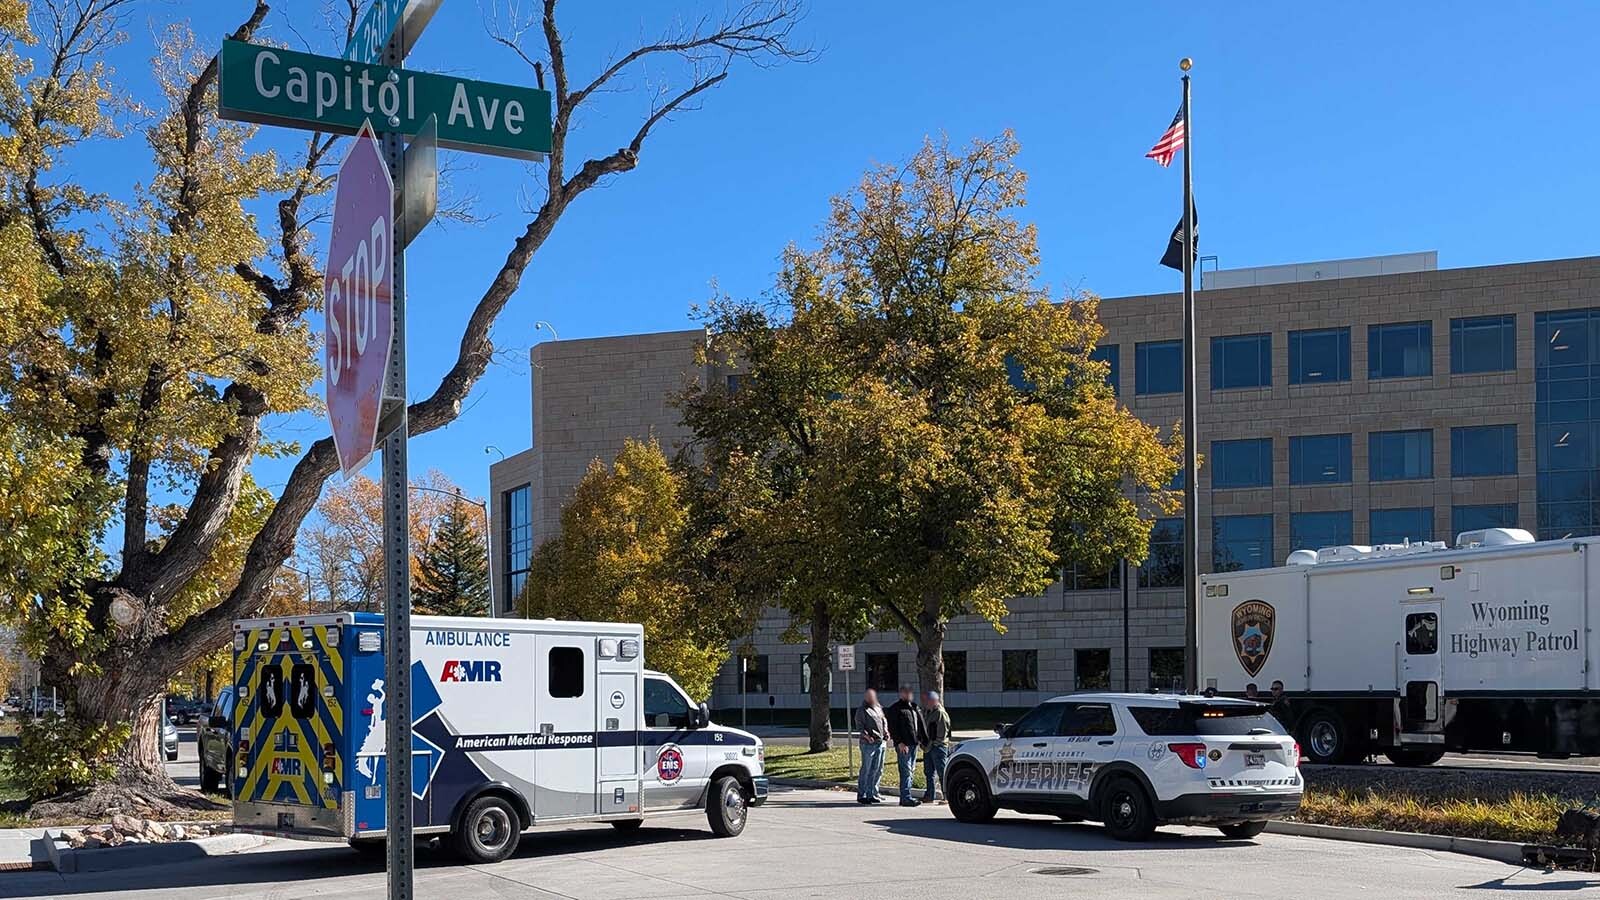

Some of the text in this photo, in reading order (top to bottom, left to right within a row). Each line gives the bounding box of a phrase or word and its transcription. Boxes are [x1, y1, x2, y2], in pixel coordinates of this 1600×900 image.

[254, 51, 525, 135] Capitol Ave
[329, 215, 387, 386] STOP
[1236, 604, 1272, 618] WYOMING
[1471, 600, 1550, 627] Wyoming
[425, 631, 511, 647] AMBULANCE
[1450, 629, 1579, 658] Highway Patrol
[440, 660, 502, 682] AMR
[455, 733, 593, 749] American Medical Response
[714, 733, 723, 742] 152
[272, 757, 301, 775] AMR
[661, 760, 679, 769] EMS
[996, 761, 1092, 790] SHERIFF
